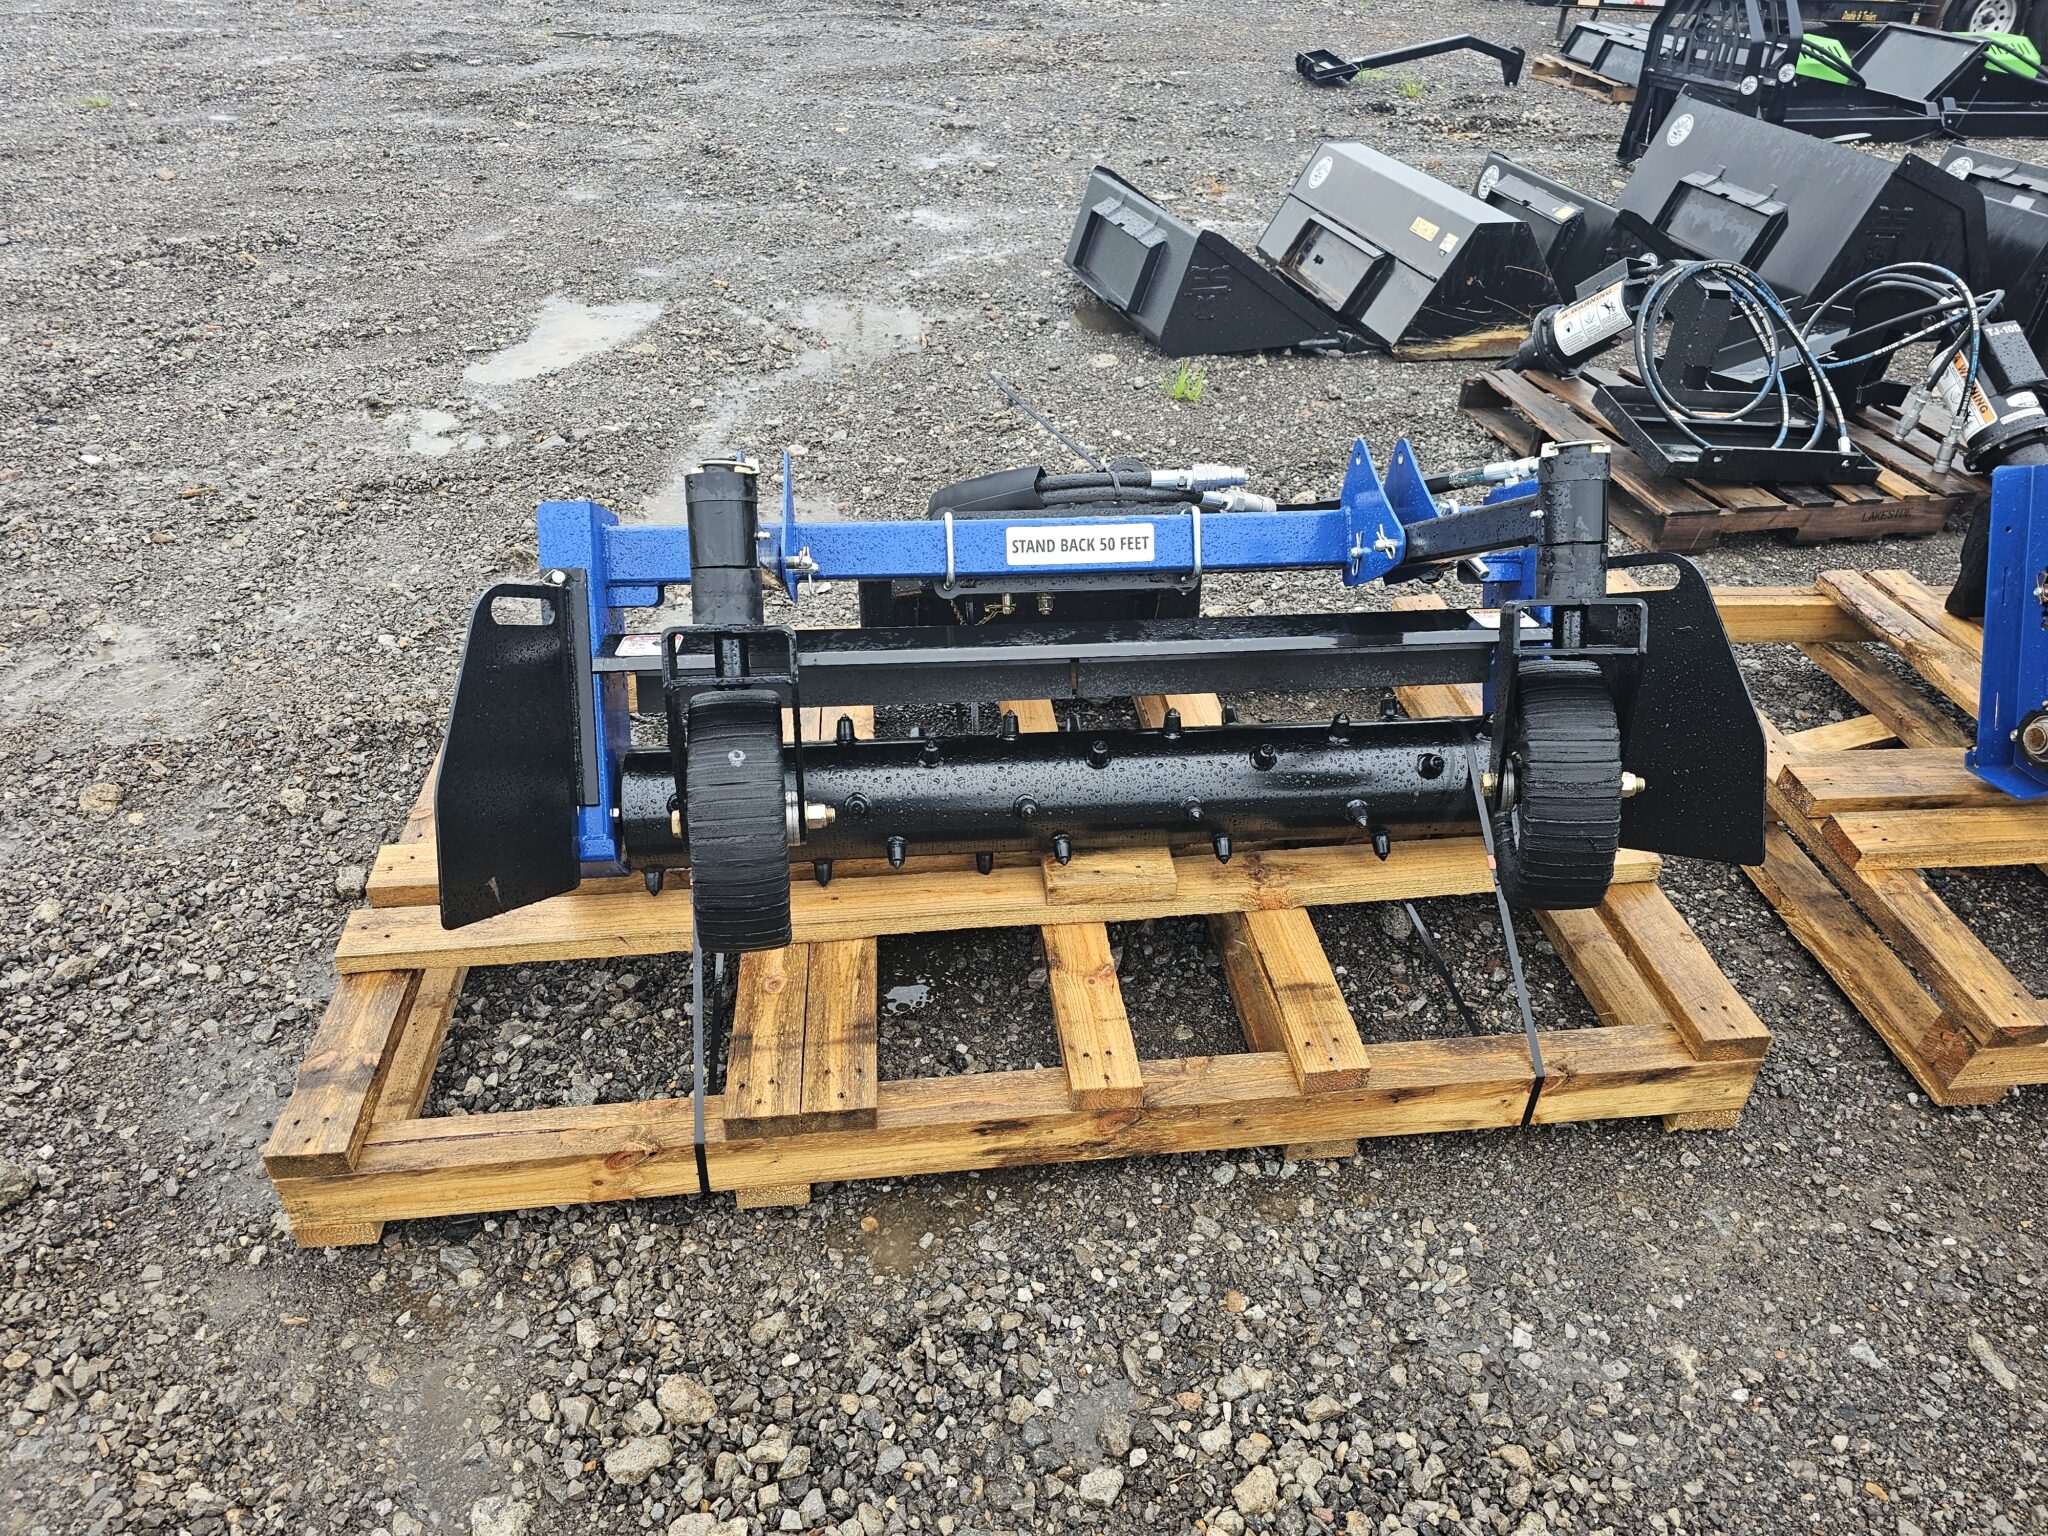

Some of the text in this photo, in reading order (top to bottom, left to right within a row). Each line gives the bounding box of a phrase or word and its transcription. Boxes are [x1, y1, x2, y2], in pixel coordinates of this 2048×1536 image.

[1570, 289, 1612, 314] WARNING
[1985, 323, 2022, 337] TJ-100
[1012, 536, 1149, 554] STAND BACK 50 FEET
